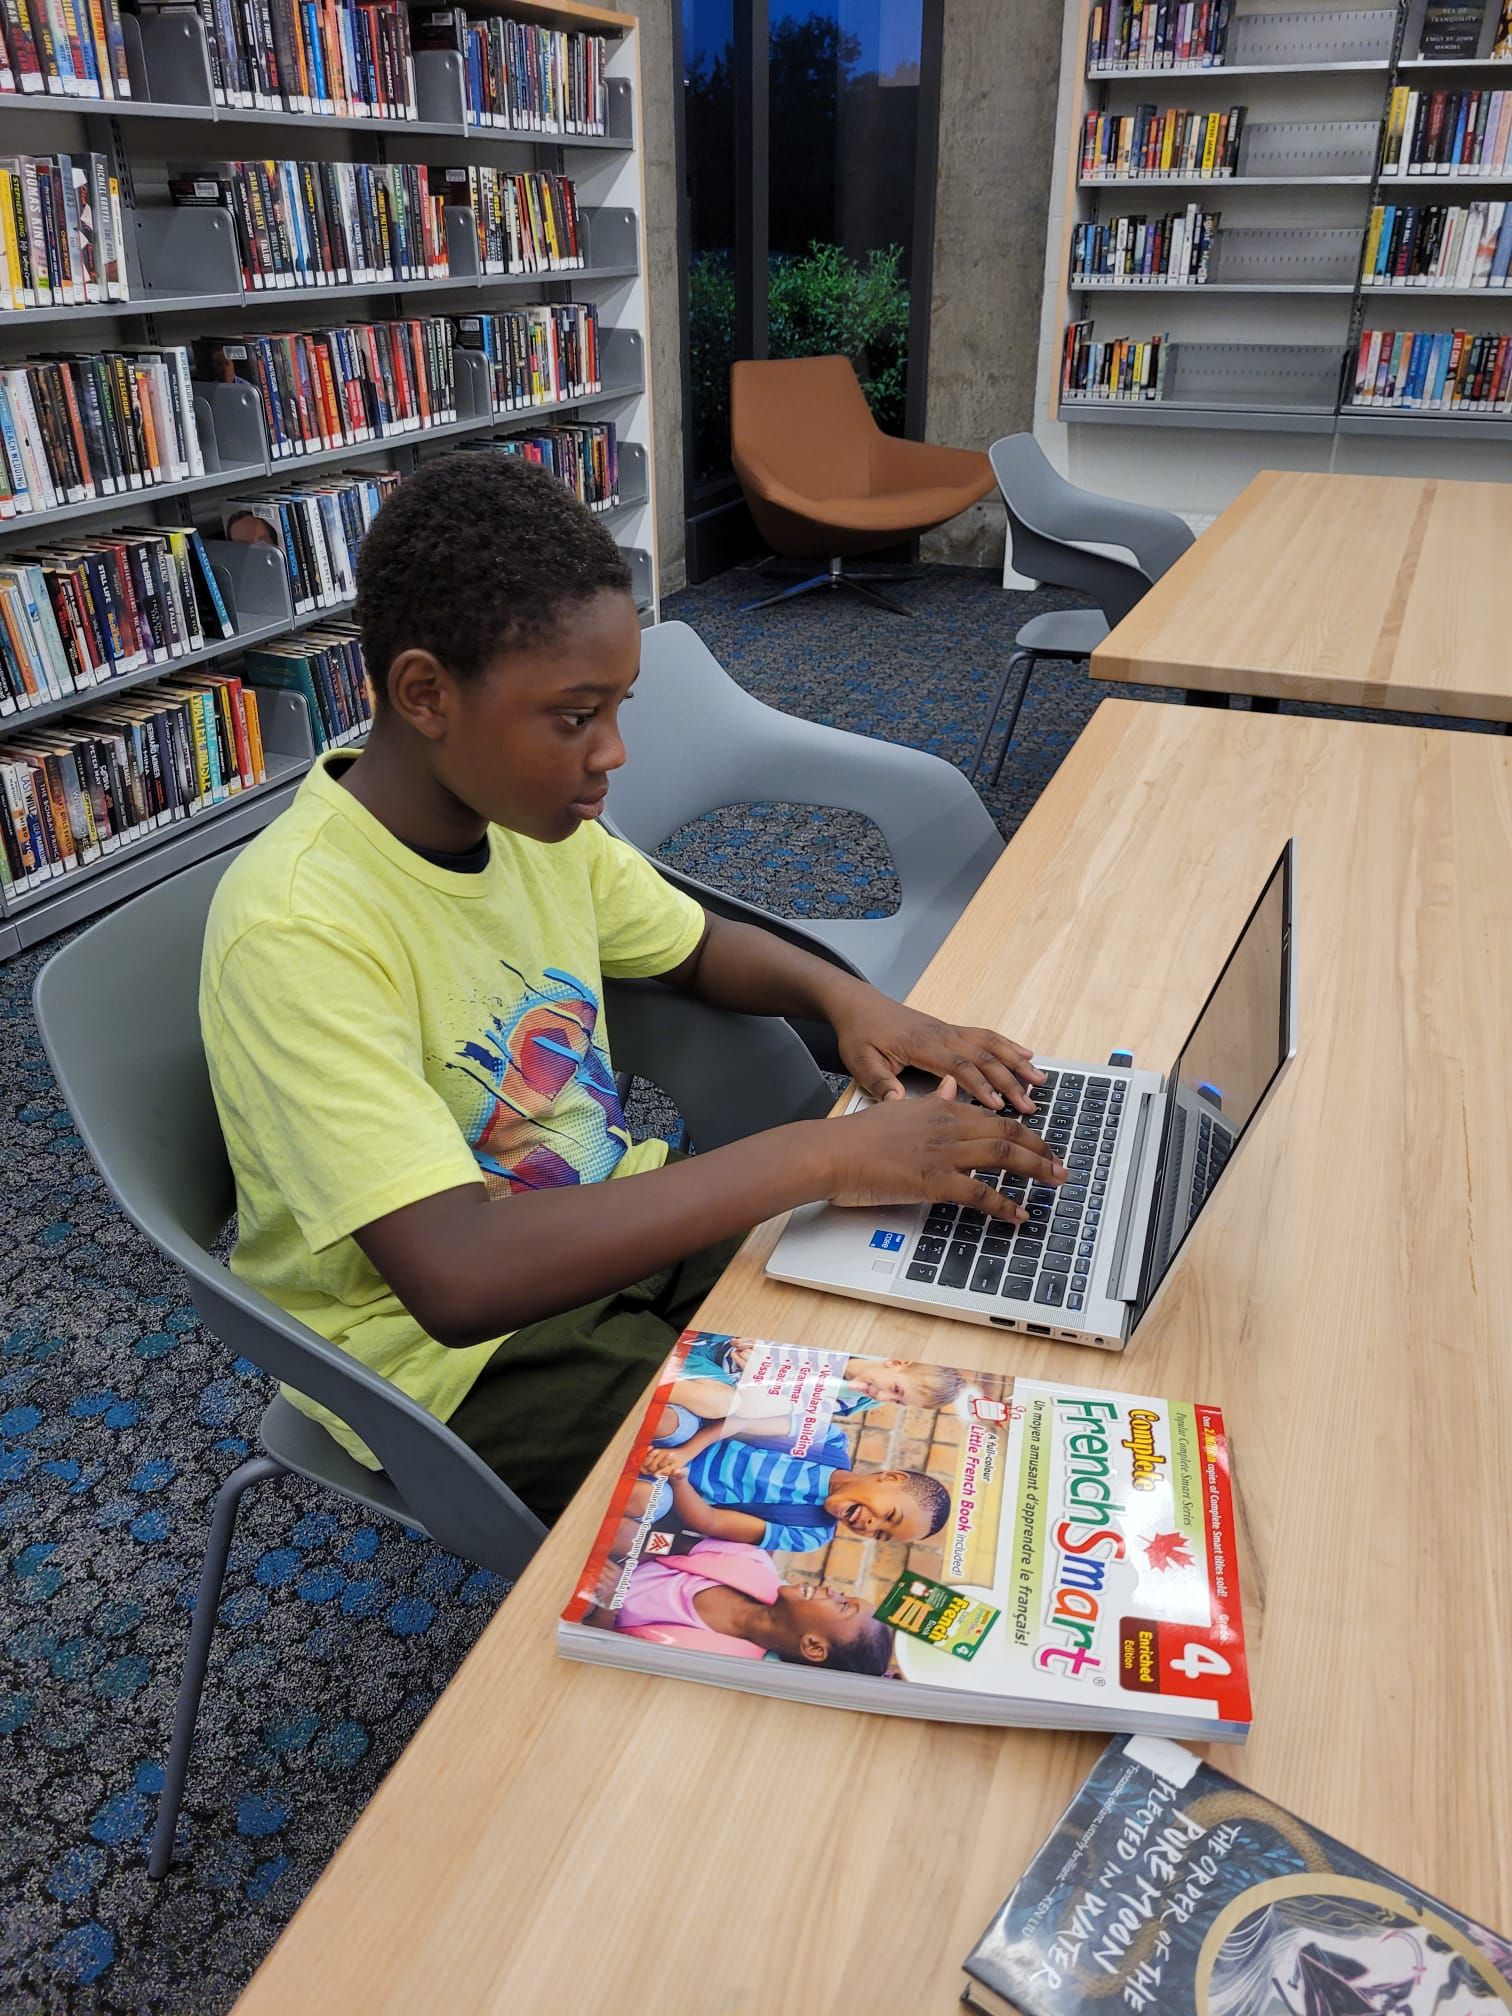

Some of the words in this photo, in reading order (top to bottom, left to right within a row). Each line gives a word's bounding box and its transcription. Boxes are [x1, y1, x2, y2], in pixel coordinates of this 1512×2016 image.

[25, 164, 40, 213] THOMAS
[96, 164, 108, 194] MICHAEL
[239, 182, 248, 202] SARA
[248, 171, 256, 191] SARA
[260, 174, 269, 190] SARA
[13, 176, 22, 215] STEPHEN
[251, 192, 265, 230] PARETSKY
[264, 192, 274, 226] PARETSKY
[377, 190, 386, 212] JAMES
[394, 168, 402, 196] JAMES
[398, 199, 407, 248] PATTERSON
[17, 216, 26, 238] KING
[32, 218, 44, 247] KING
[242, 203, 254, 238] PARETSKY
[380, 214, 390, 249] PATTERSON
[260, 240, 272, 267] FALLOUT
[116, 360, 126, 377] JOHN
[266, 344, 275, 362] JAMES
[172, 374, 180, 394] WILDE
[268, 362, 278, 392] PATTERSON
[429, 350, 437, 391] PATTERSON
[438, 349, 446, 390] PATTERSON
[118, 379, 130, 419] LESCROART
[4, 425, 16, 451] BEACH
[10, 452, 26, 487] WEDDING
[138, 548, 148, 560] VAL
[200, 546, 215, 577] PAULA
[98, 564, 108, 586] STILL
[103, 587, 112, 604] LIFE
[168, 607, 178, 634] FALLEN
[193, 697, 206, 744] WALTER
[89, 745, 98, 769] PETER
[146, 723, 157, 754] BERNARD
[152, 756, 161, 778] MINIER
[21, 775, 32, 794] LAST
[93, 770, 101, 785] MAY
[198, 751, 212, 792] MOSLE
[26, 794, 37, 814] WILL
[39, 783, 48, 798] THE
[43, 800, 55, 832] BOMBAY
[84, 792, 92, 813] COFFIN
[88, 815, 96, 833] ROAD
[32, 822, 40, 836] LIZA
[36, 836, 48, 866] MARKLUND
[49, 835, 59, 861] PRINCE
[791, 1367, 810, 1403] Grammar
[1034, 1400, 1046, 1411] Un
[793, 1418, 816, 1456] Building
[968, 1425, 984, 1453] Little
[1029, 1412, 1042, 1442] moyen
[1174, 1412, 1187, 1439] Popular
[983, 1442, 996, 1482] full-colour
[1121, 1409, 1166, 1491] Complete
[1176, 1438, 1191, 1472] Complete
[962, 1456, 980, 1496] French
[1026, 1444, 1040, 1489] amusant
[1206, 1464, 1217, 1484] copies
[652, 1476, 666, 1502] Popular
[1180, 1473, 1193, 1498] Smart
[1210, 1485, 1218, 1494] of
[645, 1504, 656, 1521] Book
[958, 1500, 974, 1532] Book
[1182, 1500, 1195, 1526] Series
[1208, 1494, 1221, 1529] Complete
[630, 1523, 650, 1558] Company
[1022, 1493, 1038, 1564] d'apprendre
[1212, 1530, 1224, 1554] Smart
[952, 1534, 967, 1576] included!
[1214, 1555, 1225, 1574] titles
[618, 1559, 638, 1592] (Canada)
[1020, 1568, 1034, 1581] le
[1216, 1576, 1228, 1597] sold!
[612, 1594, 624, 1608] Ltd.
[1013, 1585, 1033, 1646] français!
[928, 1597, 970, 1641] French
[1218, 1614, 1230, 1641] Grade
[1124, 1640, 1135, 1669] Edition
[1138, 1631, 1155, 1682] Enriched
[1169, 1643, 1232, 1679] 4
[1116, 1771, 1177, 1861] FLECTED
[1143, 1808, 1207, 1881] PURE
[1208, 1824, 1241, 1856] THE
[1100, 1861, 1122, 1888] IN
[1160, 1855, 1218, 1924] ORDER
[1029, 1891, 1107, 1989] WATER
[1093, 1874, 1162, 1975] MOON
[1154, 1930, 1171, 1962] OF
[1125, 1960, 1161, 2012] THE
